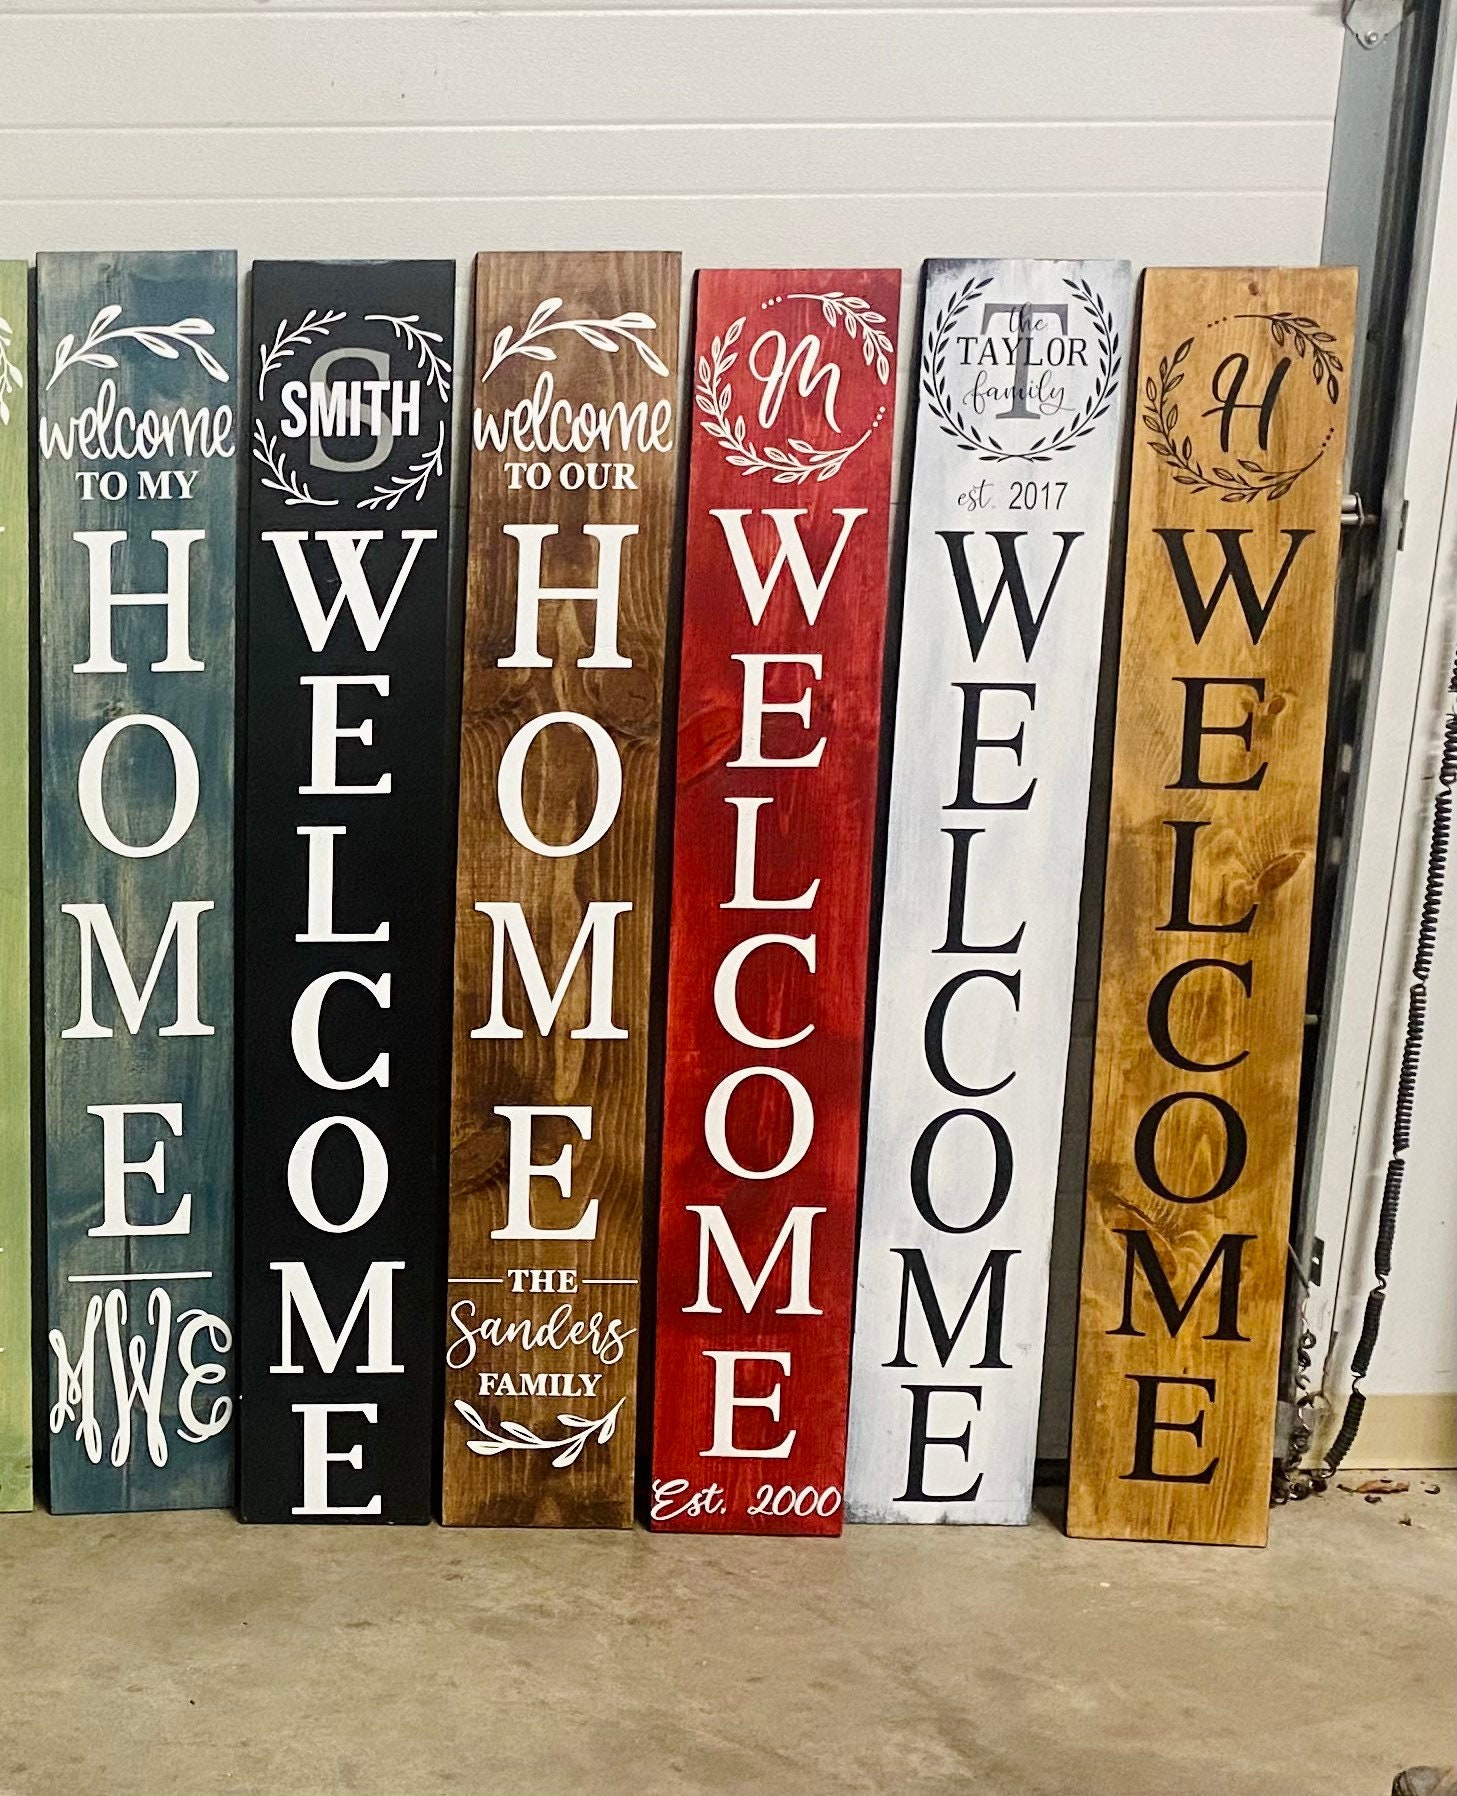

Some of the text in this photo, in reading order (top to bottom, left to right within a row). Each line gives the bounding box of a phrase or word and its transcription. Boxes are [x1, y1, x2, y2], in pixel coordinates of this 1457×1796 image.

[957, 337, 1088, 367] TAYLOR
[1008, 303, 1048, 334] the
[280, 380, 420, 437] SMITH
[473, 371, 673, 453] welcome
[749, 329, 841, 434] M
[962, 370, 1075, 415] family
[1201, 353, 1291, 452] H
[39, 378, 235, 459] welcome
[76, 471, 199, 500] TO MY
[504, 463, 638, 490] TO OUR
[1009, 482, 1068, 510] 2017
[61, 530, 215, 1237] HOME
[470, 524, 640, 1240] HOME
[681, 508, 868, 1459] WELCOME
[881, 530, 1085, 1502] WELCOME
[1105, 528, 1316, 1484] WELCOME
[261, 529, 438, 1515] WELCOME
[508, 1269, 578, 1293] THE
[446, 1300, 636, 1369] Sanders
[478, 1373, 602, 1397] FAMILY
[651, 1479, 841, 1521] Est. 2000
